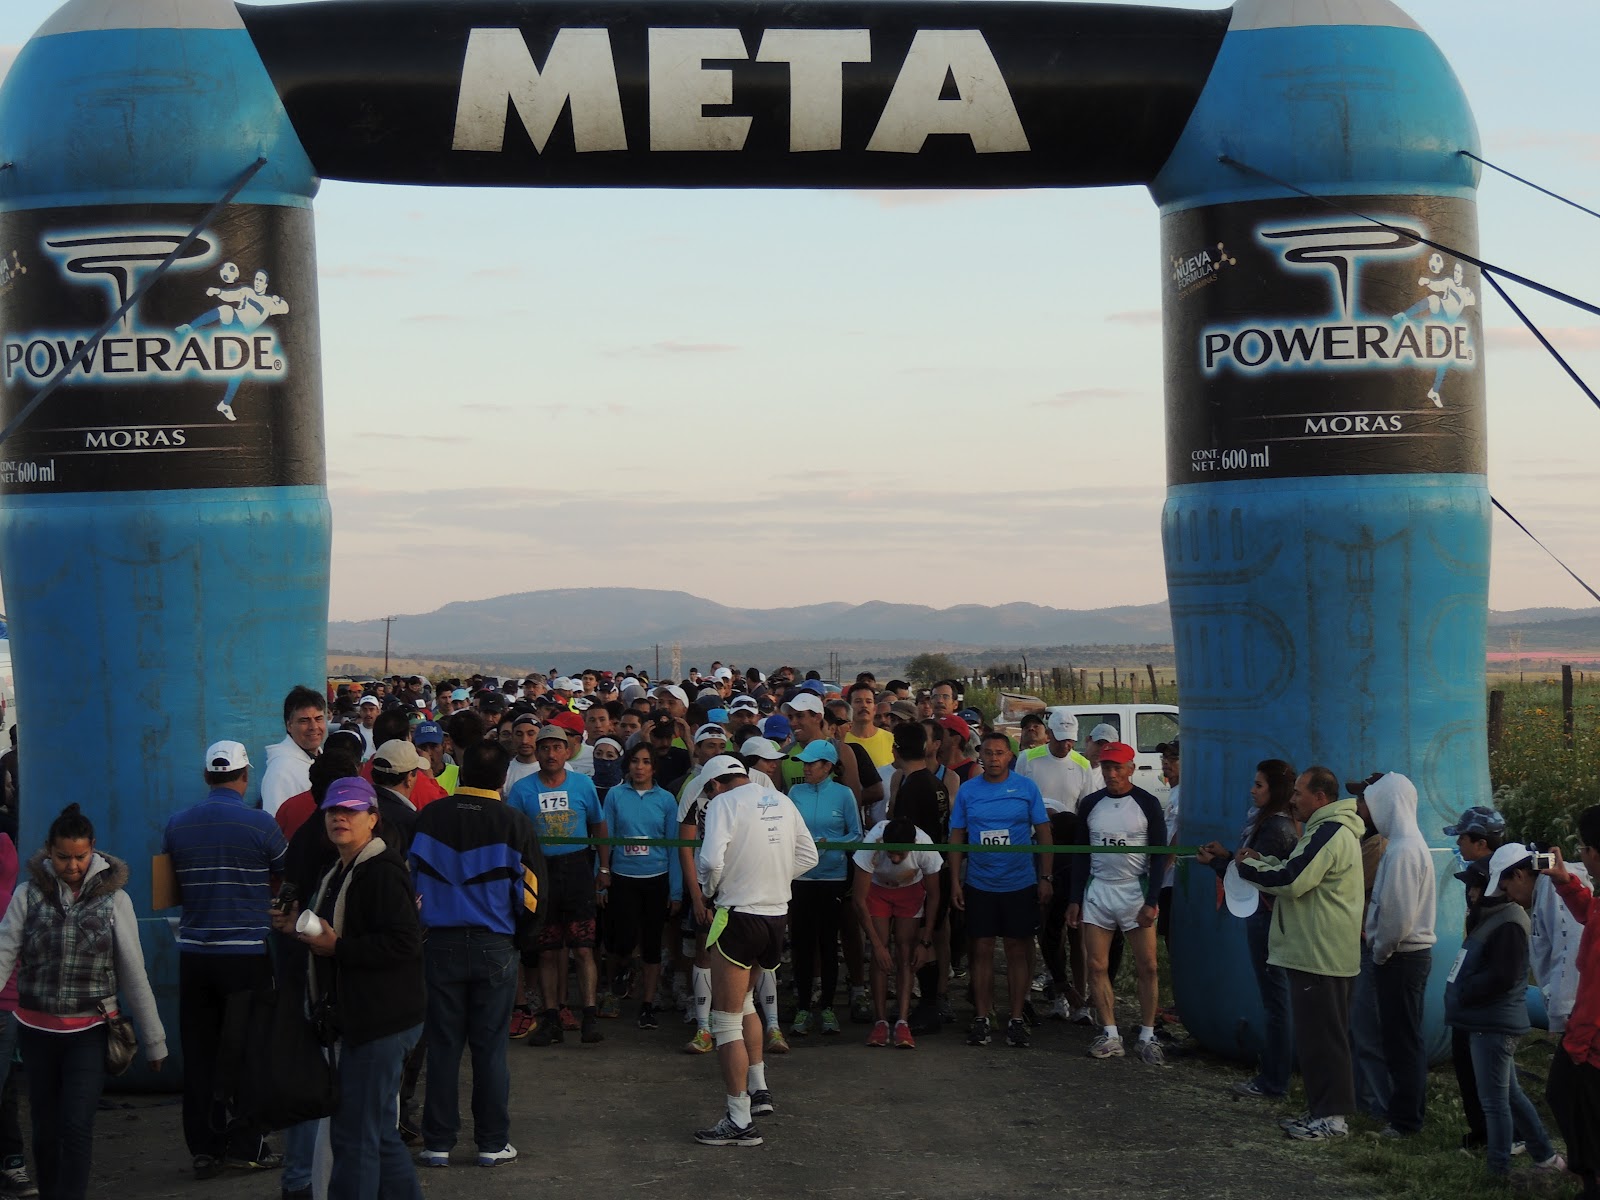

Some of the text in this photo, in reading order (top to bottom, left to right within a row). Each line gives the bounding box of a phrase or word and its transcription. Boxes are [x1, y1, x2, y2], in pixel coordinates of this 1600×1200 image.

[452, 27, 1031, 155] META
[1176, 251, 1211, 281] NUEVA
[1205, 325, 1469, 368] POWERADE
[6, 336, 275, 378] POWERADE
[1304, 415, 1402, 434] MORAS
[86, 430, 186, 448] MORAS
[1191, 449, 1220, 461] CONT.
[1221, 445, 1270, 470] 600 ml
[18, 459, 55, 483] 600 ml
[1192, 461, 1221, 472] NET.
[541, 797, 567, 809] 175
[983, 835, 1009, 846] 067
[1101, 837, 1126, 847] 156
